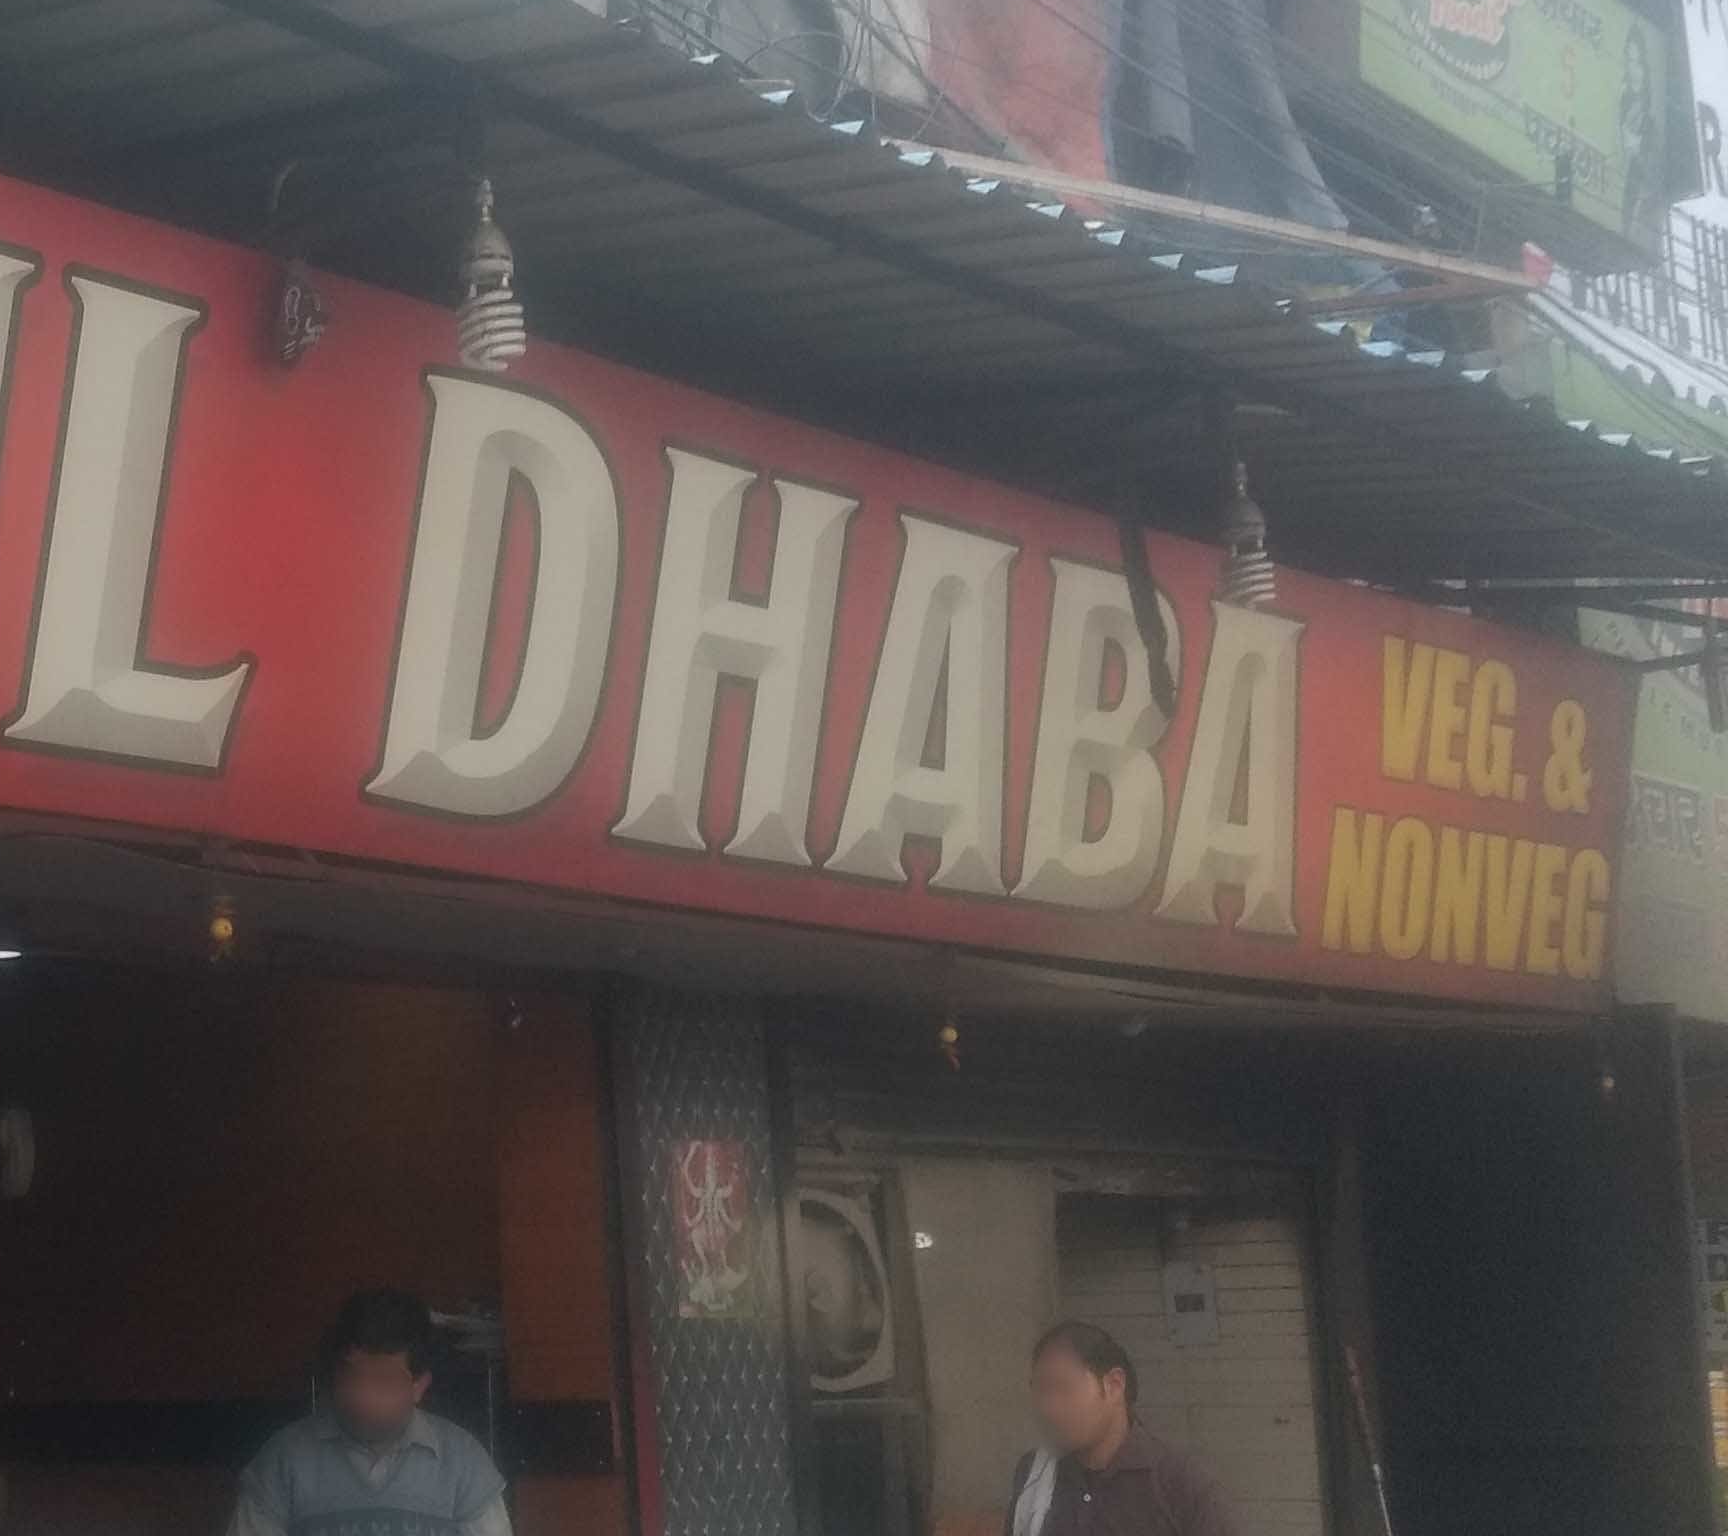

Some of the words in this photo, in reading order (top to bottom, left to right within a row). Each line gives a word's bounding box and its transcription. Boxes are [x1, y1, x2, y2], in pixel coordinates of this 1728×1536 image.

[362, 368, 1307, 938] DHABA
[1381, 634, 1527, 802] VEG.
[1543, 699, 1593, 815] &
[1321, 805, 1611, 981] NONVEG
